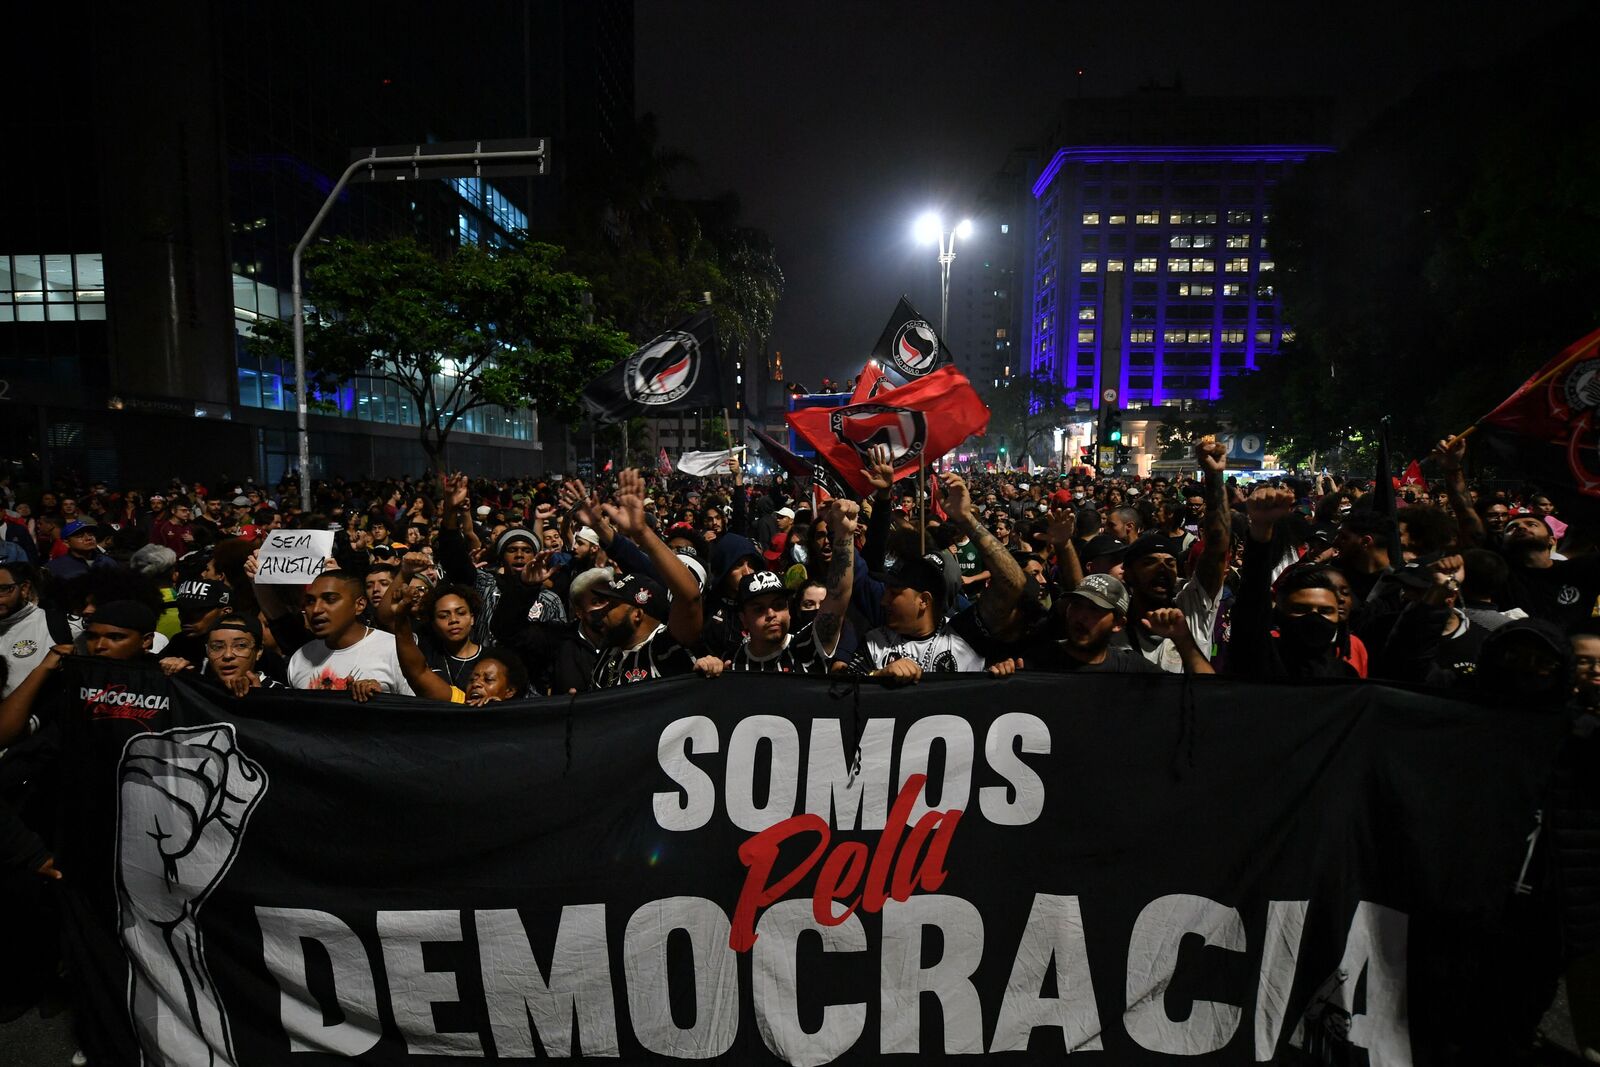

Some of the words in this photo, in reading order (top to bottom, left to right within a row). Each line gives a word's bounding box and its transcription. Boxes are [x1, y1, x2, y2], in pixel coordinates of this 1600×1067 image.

[259, 555, 326, 576] ANISTIA
[271, 534, 312, 549] SEM
[79, 686, 170, 711] DEMOCRACIA
[652, 712, 1052, 832] SOMOS
[729, 773, 964, 953] Pela
[253, 892, 1414, 1067] DEMOCRACIA
